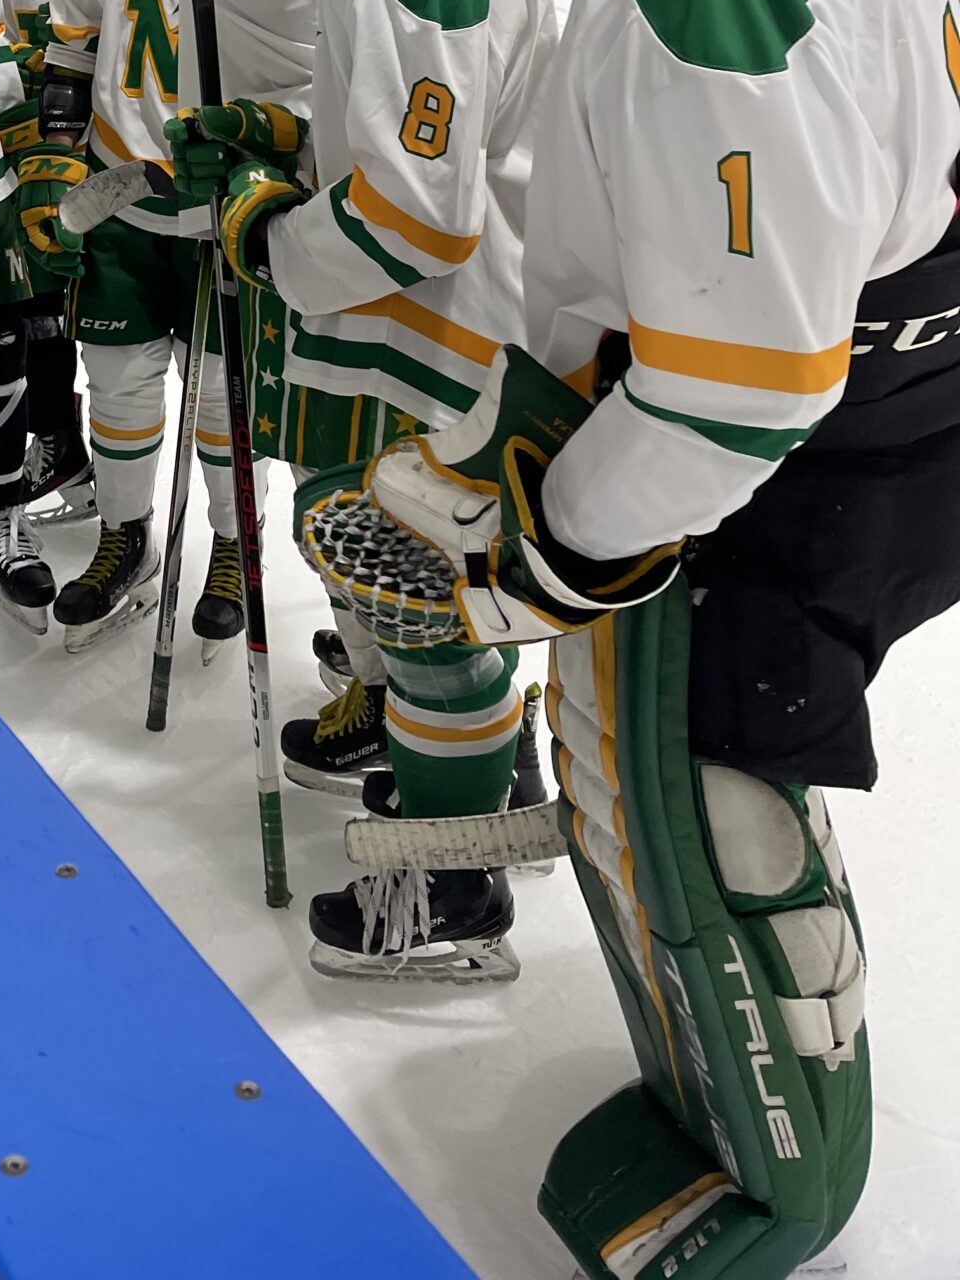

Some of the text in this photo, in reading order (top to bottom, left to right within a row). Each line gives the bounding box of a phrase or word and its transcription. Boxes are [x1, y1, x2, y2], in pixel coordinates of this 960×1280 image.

[398, 76, 456, 161] 8
[717, 150, 755, 259] 1
[5, 249, 25, 284] N
[80, 317, 128, 331] CCM
[232, 375, 243, 404] TEAM
[30, 470, 54, 492] CCM
[237, 426, 262, 593] JETSPEED
[335, 742, 379, 767] BAUER
[724, 934, 802, 1160] TRUE
